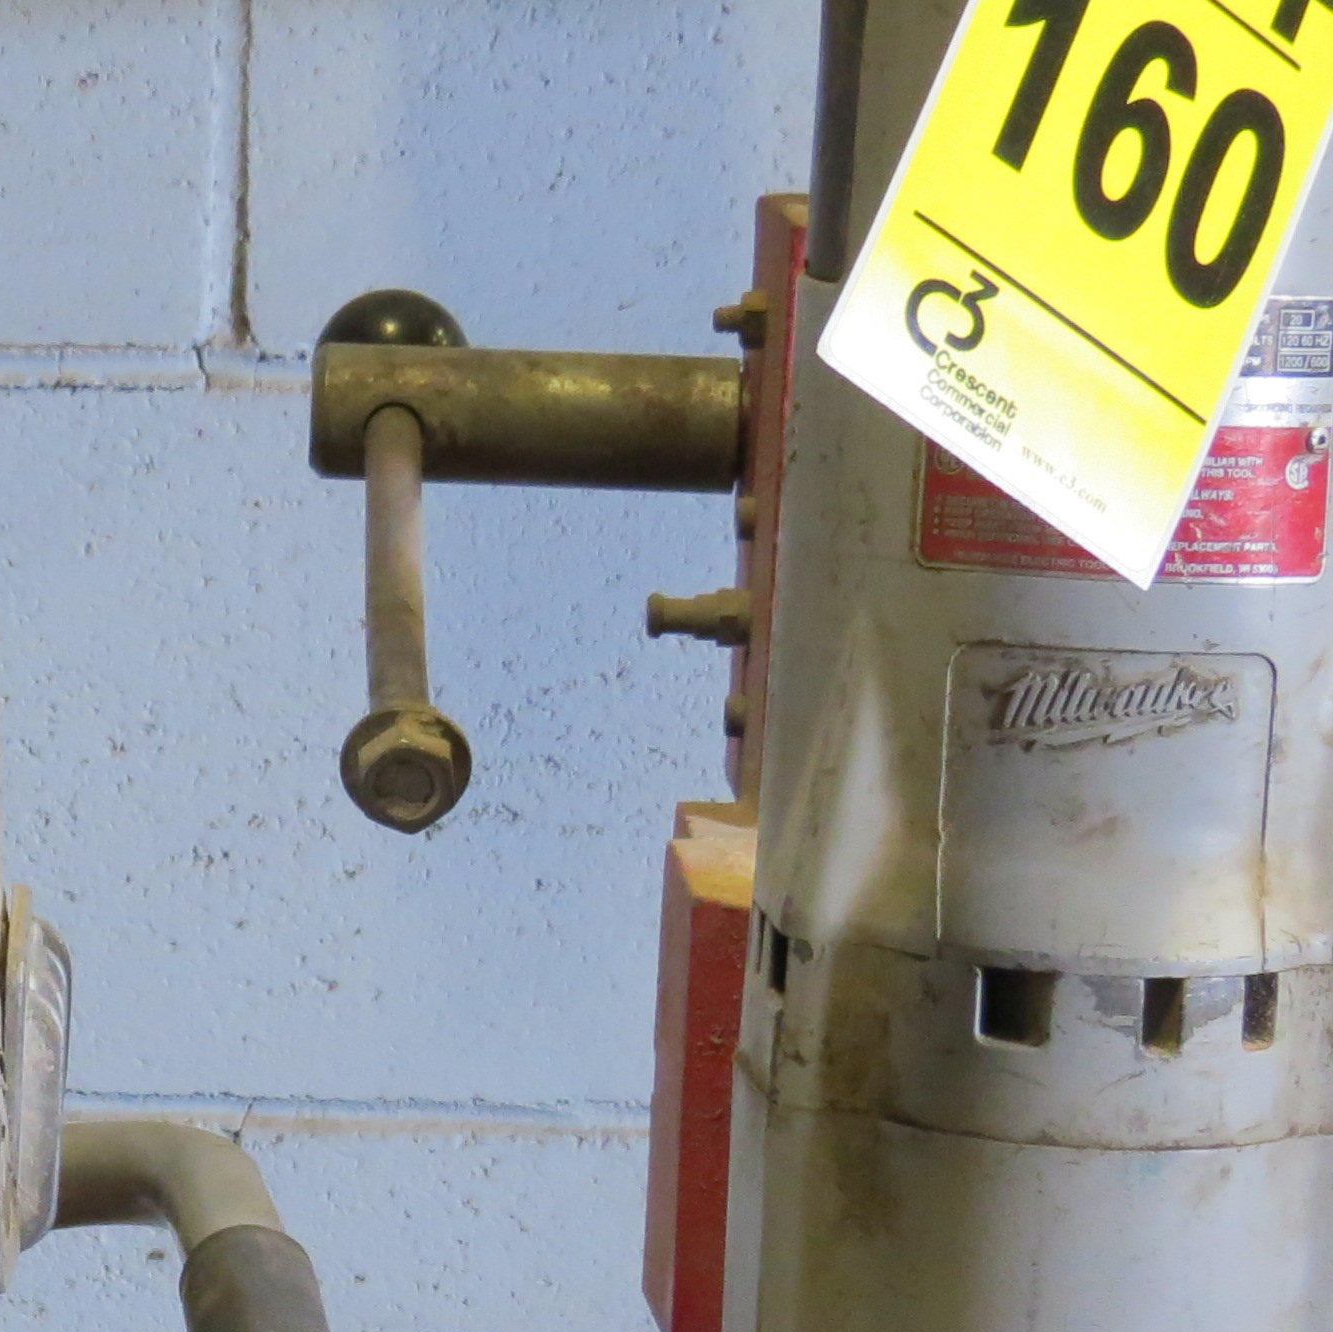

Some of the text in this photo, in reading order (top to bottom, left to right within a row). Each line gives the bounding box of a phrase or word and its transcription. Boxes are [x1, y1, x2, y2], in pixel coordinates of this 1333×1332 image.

[992, 0, 1285, 309] 160
[920, 385, 1003, 452] Corporation
[927, 368, 1012, 437] Commercial
[935, 350, 1018, 419] Crescent
[1022, 445, 1106, 513] www.c3.com
